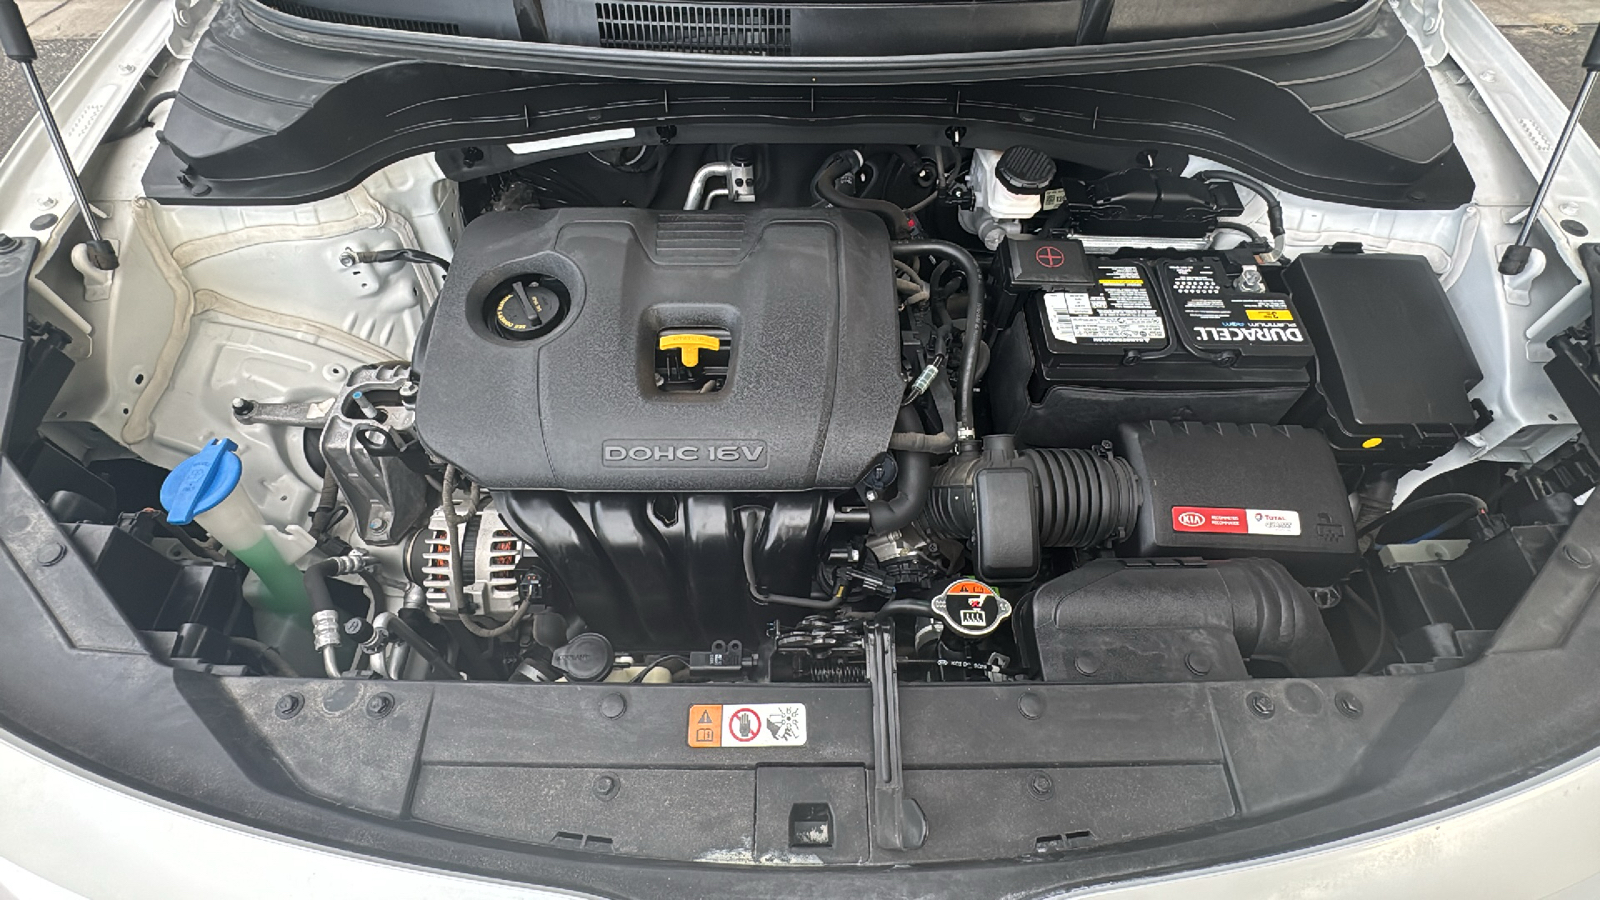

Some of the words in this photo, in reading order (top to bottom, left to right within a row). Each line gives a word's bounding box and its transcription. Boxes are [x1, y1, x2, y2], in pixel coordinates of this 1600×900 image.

[1193, 326, 1304, 342] DURACELL
[604, 446, 699, 461] DOHC
[708, 446, 764, 461] 16V
[1181, 514, 1202, 525] KIA
